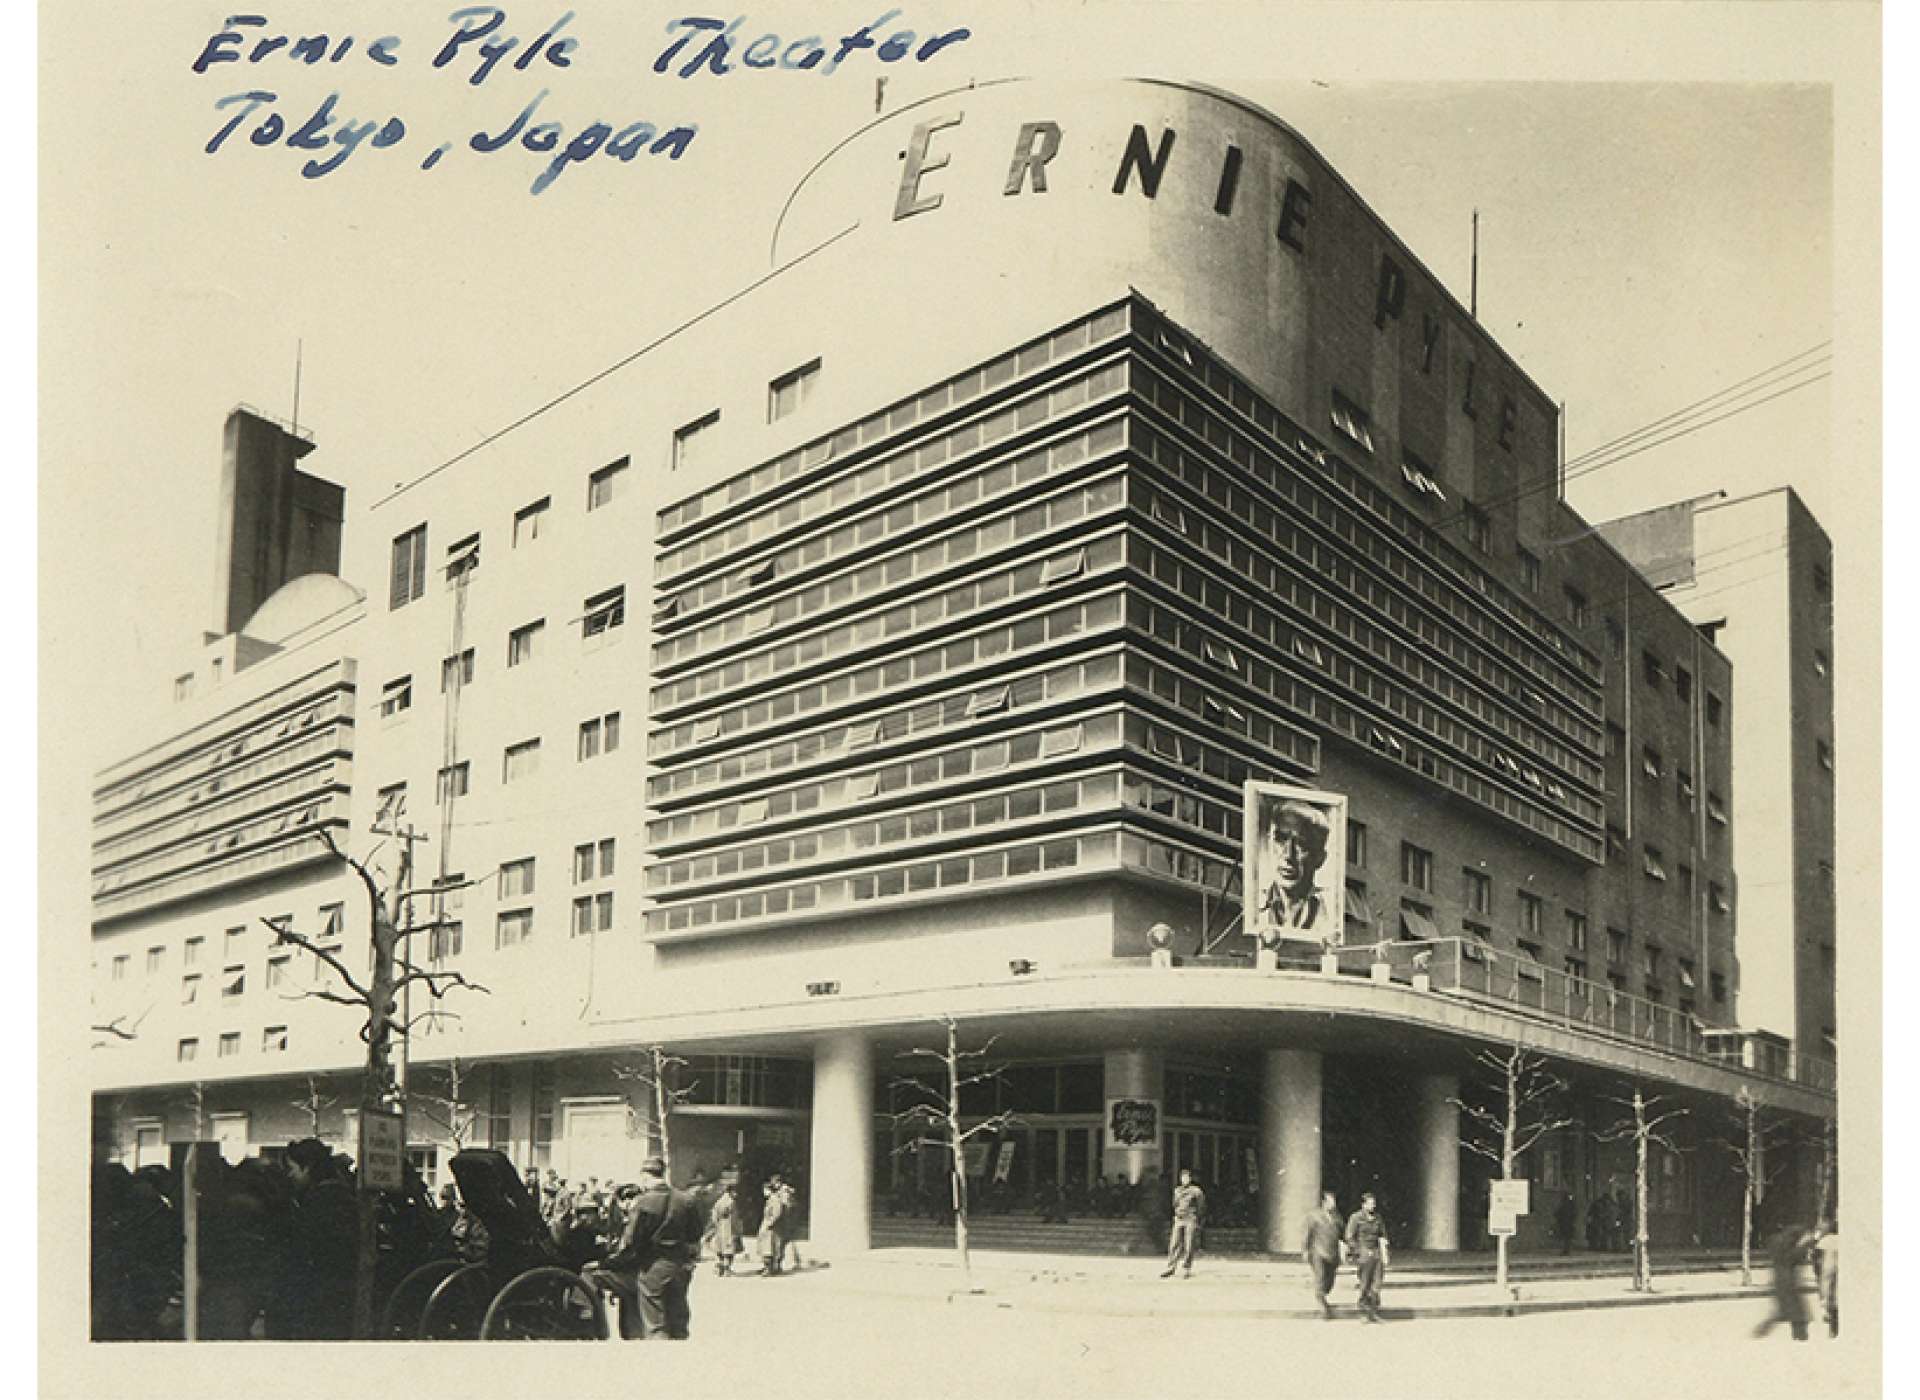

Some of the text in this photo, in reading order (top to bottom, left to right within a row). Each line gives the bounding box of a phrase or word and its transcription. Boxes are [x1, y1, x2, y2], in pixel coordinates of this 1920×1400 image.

[193, 7, 973, 86] Ernie Pyle Theater
[467, 88, 699, 197] Japan
[892, 110, 1520, 454] ERNIE PYLE
